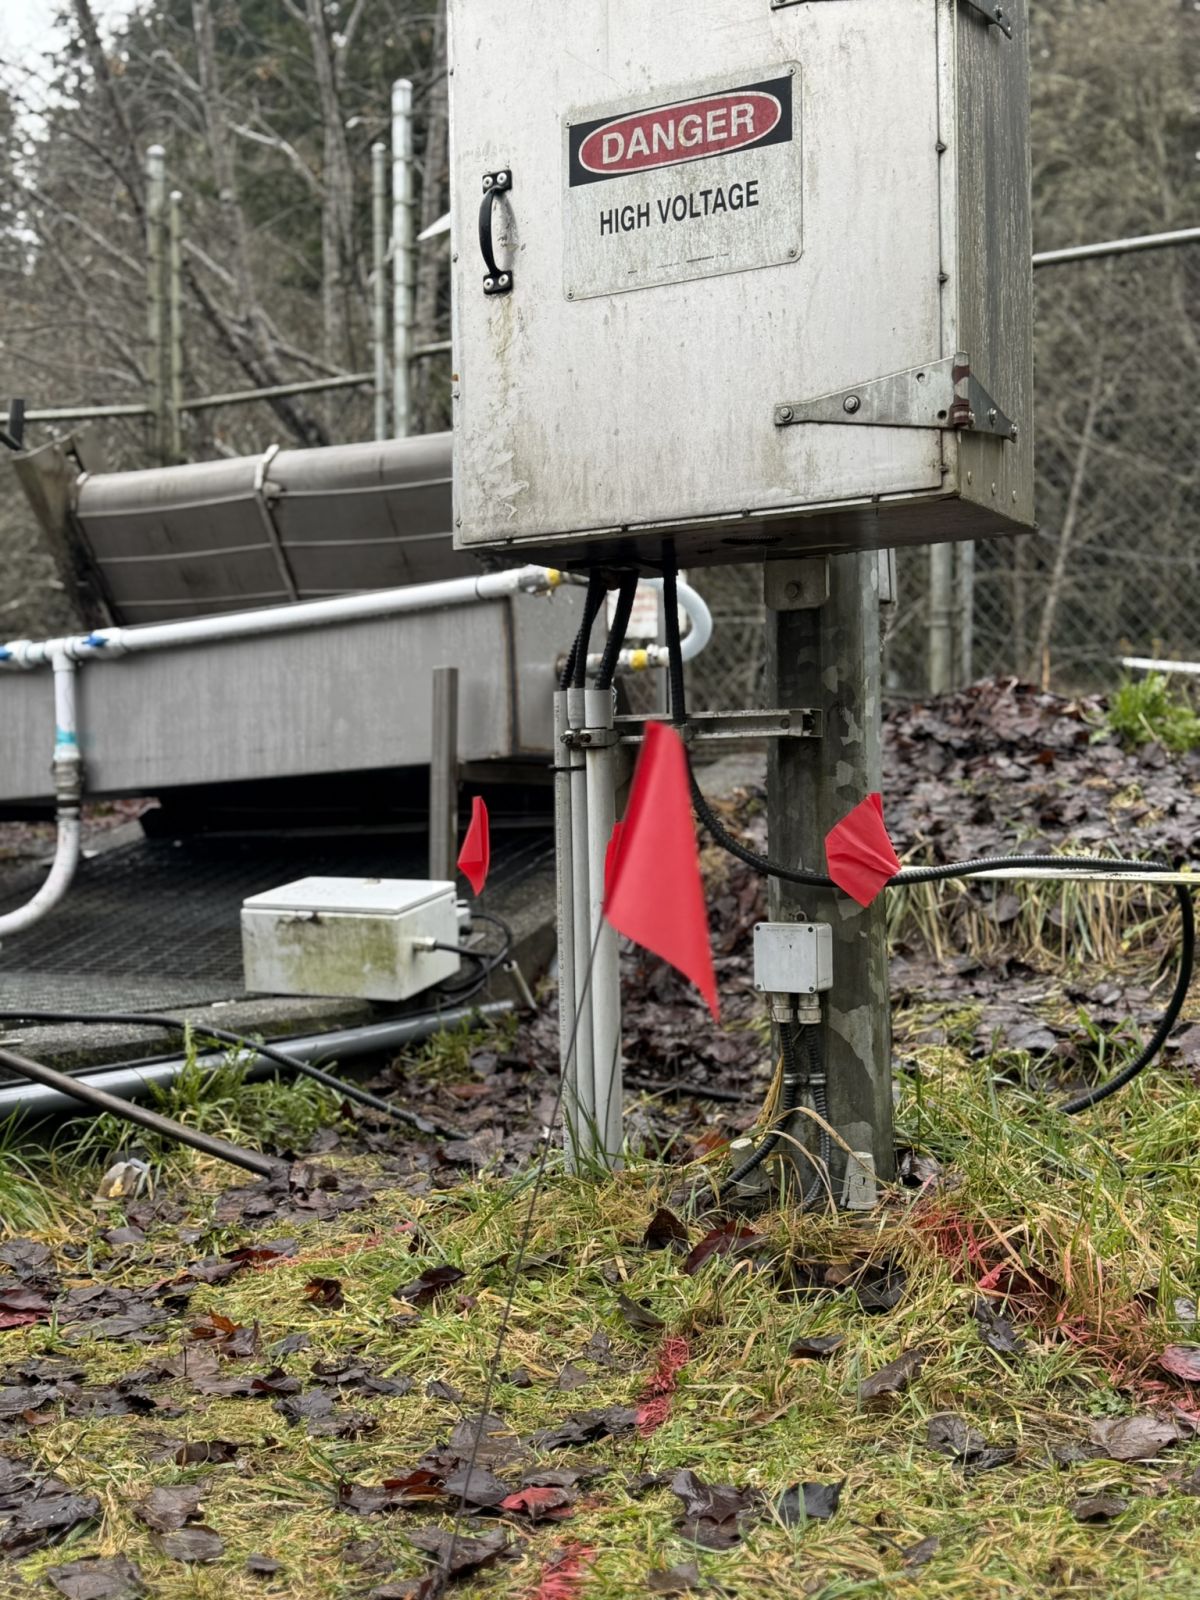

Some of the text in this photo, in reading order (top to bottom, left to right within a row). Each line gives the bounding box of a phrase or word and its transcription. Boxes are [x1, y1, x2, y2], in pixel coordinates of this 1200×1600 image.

[602, 103, 755, 165] DANGER
[600, 180, 759, 236] HIGH VOLTAGE
